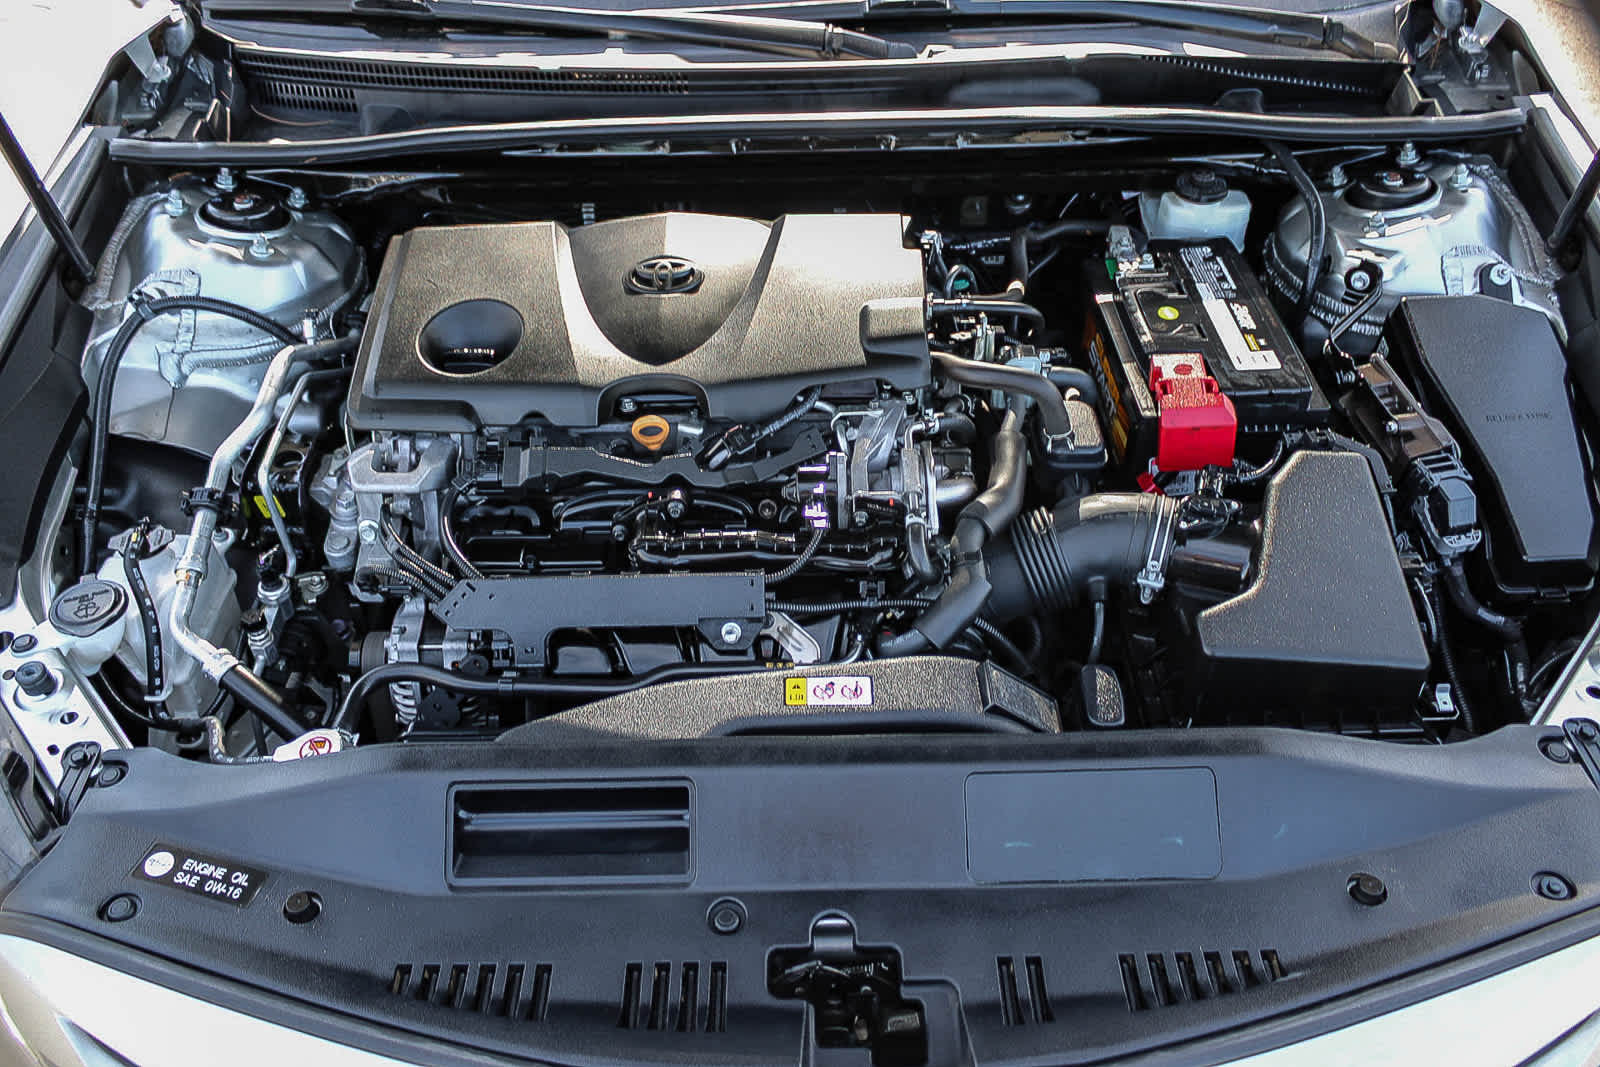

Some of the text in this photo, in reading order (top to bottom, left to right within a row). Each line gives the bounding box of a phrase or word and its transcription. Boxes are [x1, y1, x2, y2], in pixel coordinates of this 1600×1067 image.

[173, 871, 243, 899] SAE 0W-16
[182, 858, 227, 880] ENGINE
[231, 871, 249, 887] OIL
